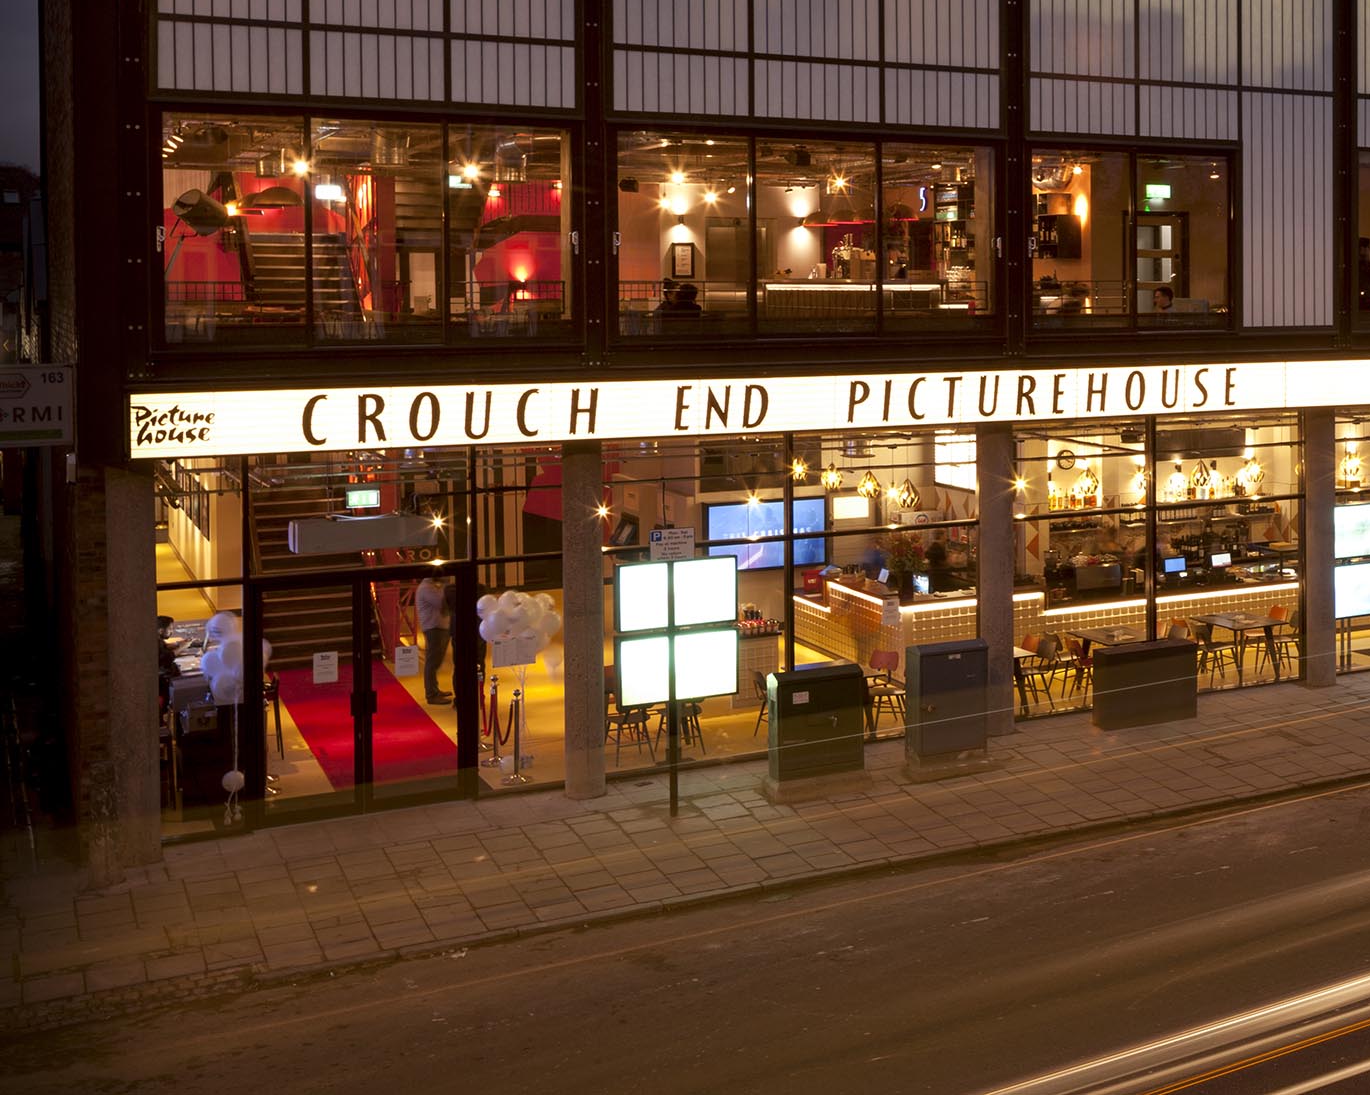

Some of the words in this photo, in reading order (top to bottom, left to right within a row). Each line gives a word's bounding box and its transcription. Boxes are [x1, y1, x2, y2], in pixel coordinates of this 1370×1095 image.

[41, 371, 65, 384] 163
[131, 404, 216, 427] Picture
[301, 387, 599, 446] CROUCH
[674, 384, 769, 431] END
[847, 367, 1237, 424] PICTUREHOUSE
[136, 421, 211, 447] house
